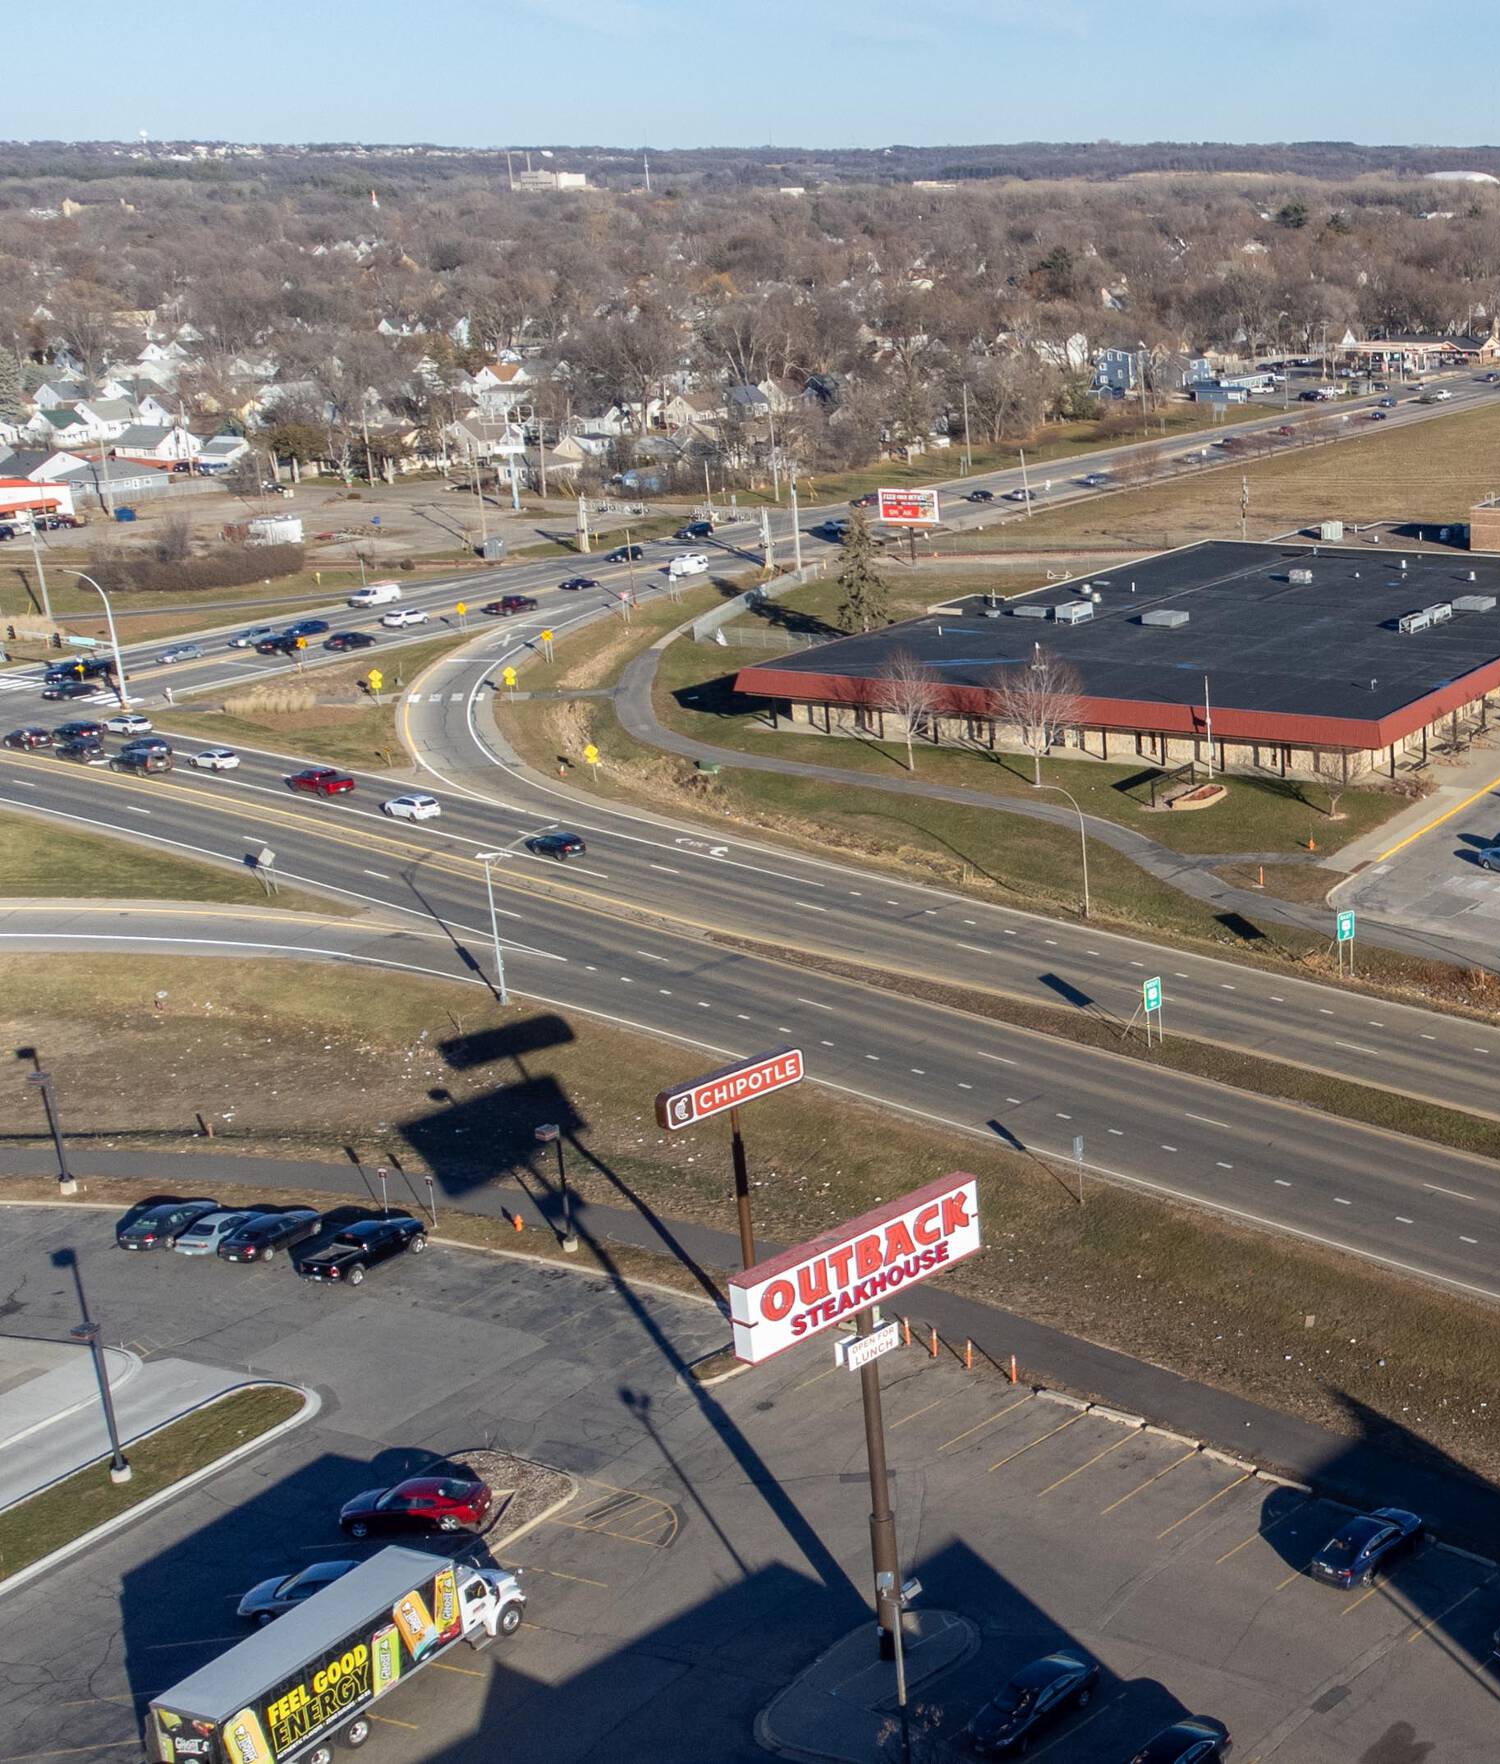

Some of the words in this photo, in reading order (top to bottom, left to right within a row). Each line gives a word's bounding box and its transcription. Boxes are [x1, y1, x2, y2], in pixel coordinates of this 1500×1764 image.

[699, 1058, 798, 1109] CHIPOTLE
[760, 1190, 970, 1322] OUTBACK
[790, 1240, 950, 1336] STEAKHOUSE
[852, 1337, 876, 1355] OPEN
[877, 1326, 895, 1342] FOR
[855, 1338, 894, 1367] LUNCH
[267, 1684, 311, 1726] FEEL
[313, 1644, 368, 1694] GOOD
[271, 1660, 369, 1753] ENERGY
